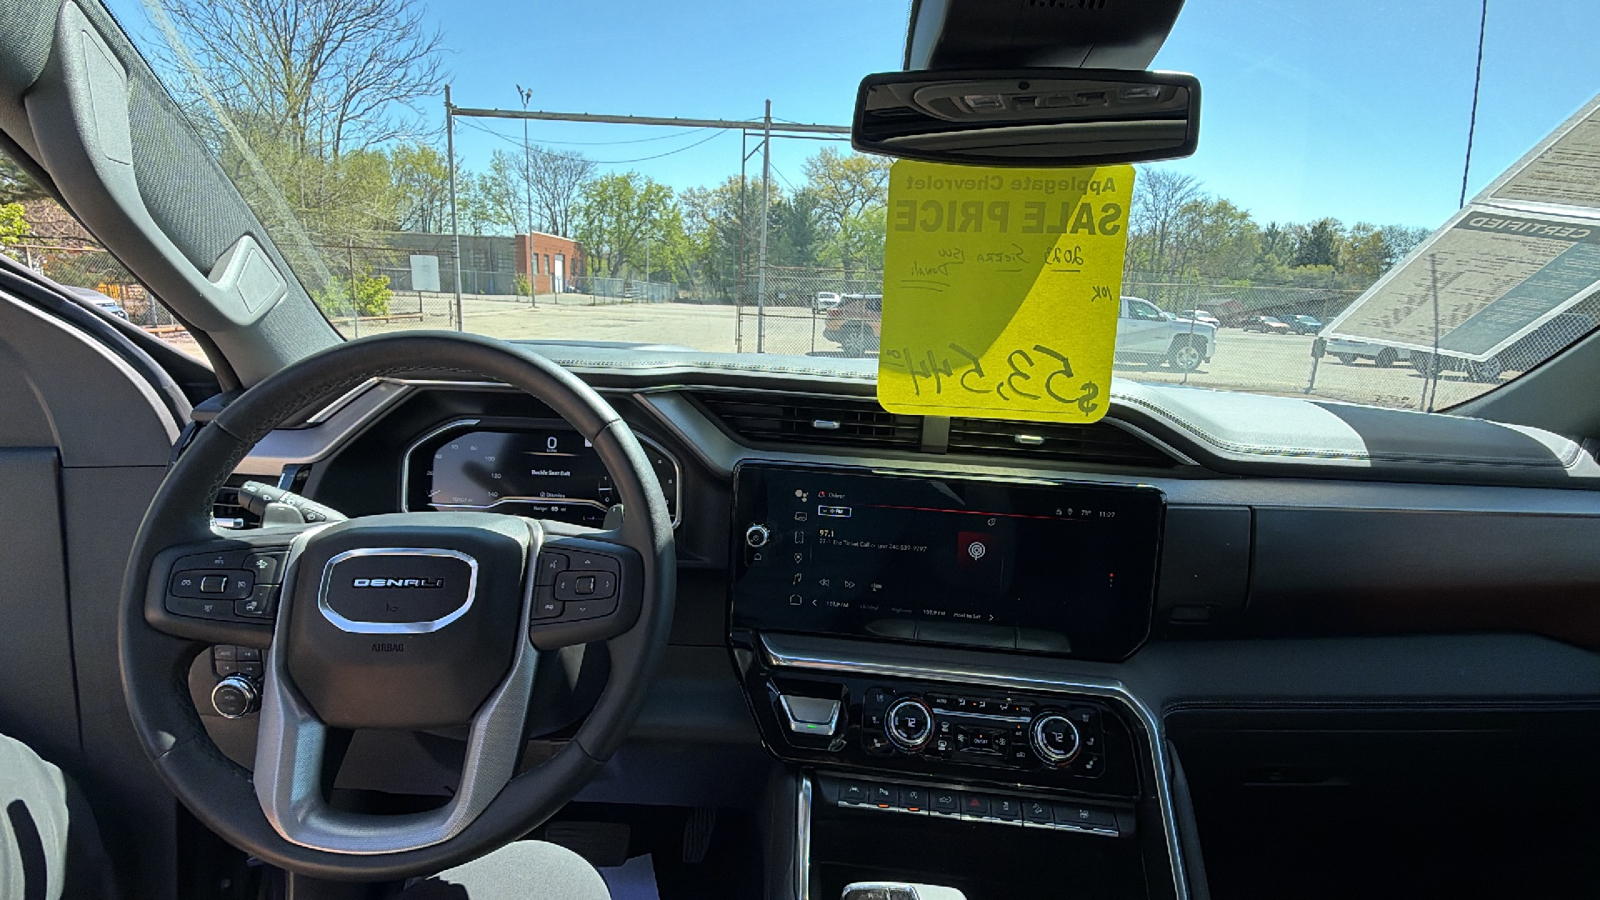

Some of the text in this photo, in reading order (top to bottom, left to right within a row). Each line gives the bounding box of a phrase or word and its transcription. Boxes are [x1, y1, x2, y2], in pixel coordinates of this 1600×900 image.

[819, 529, 835, 538] 97.1
[353, 578, 444, 588] DENALI
[372, 643, 405, 652] AIRBAG
